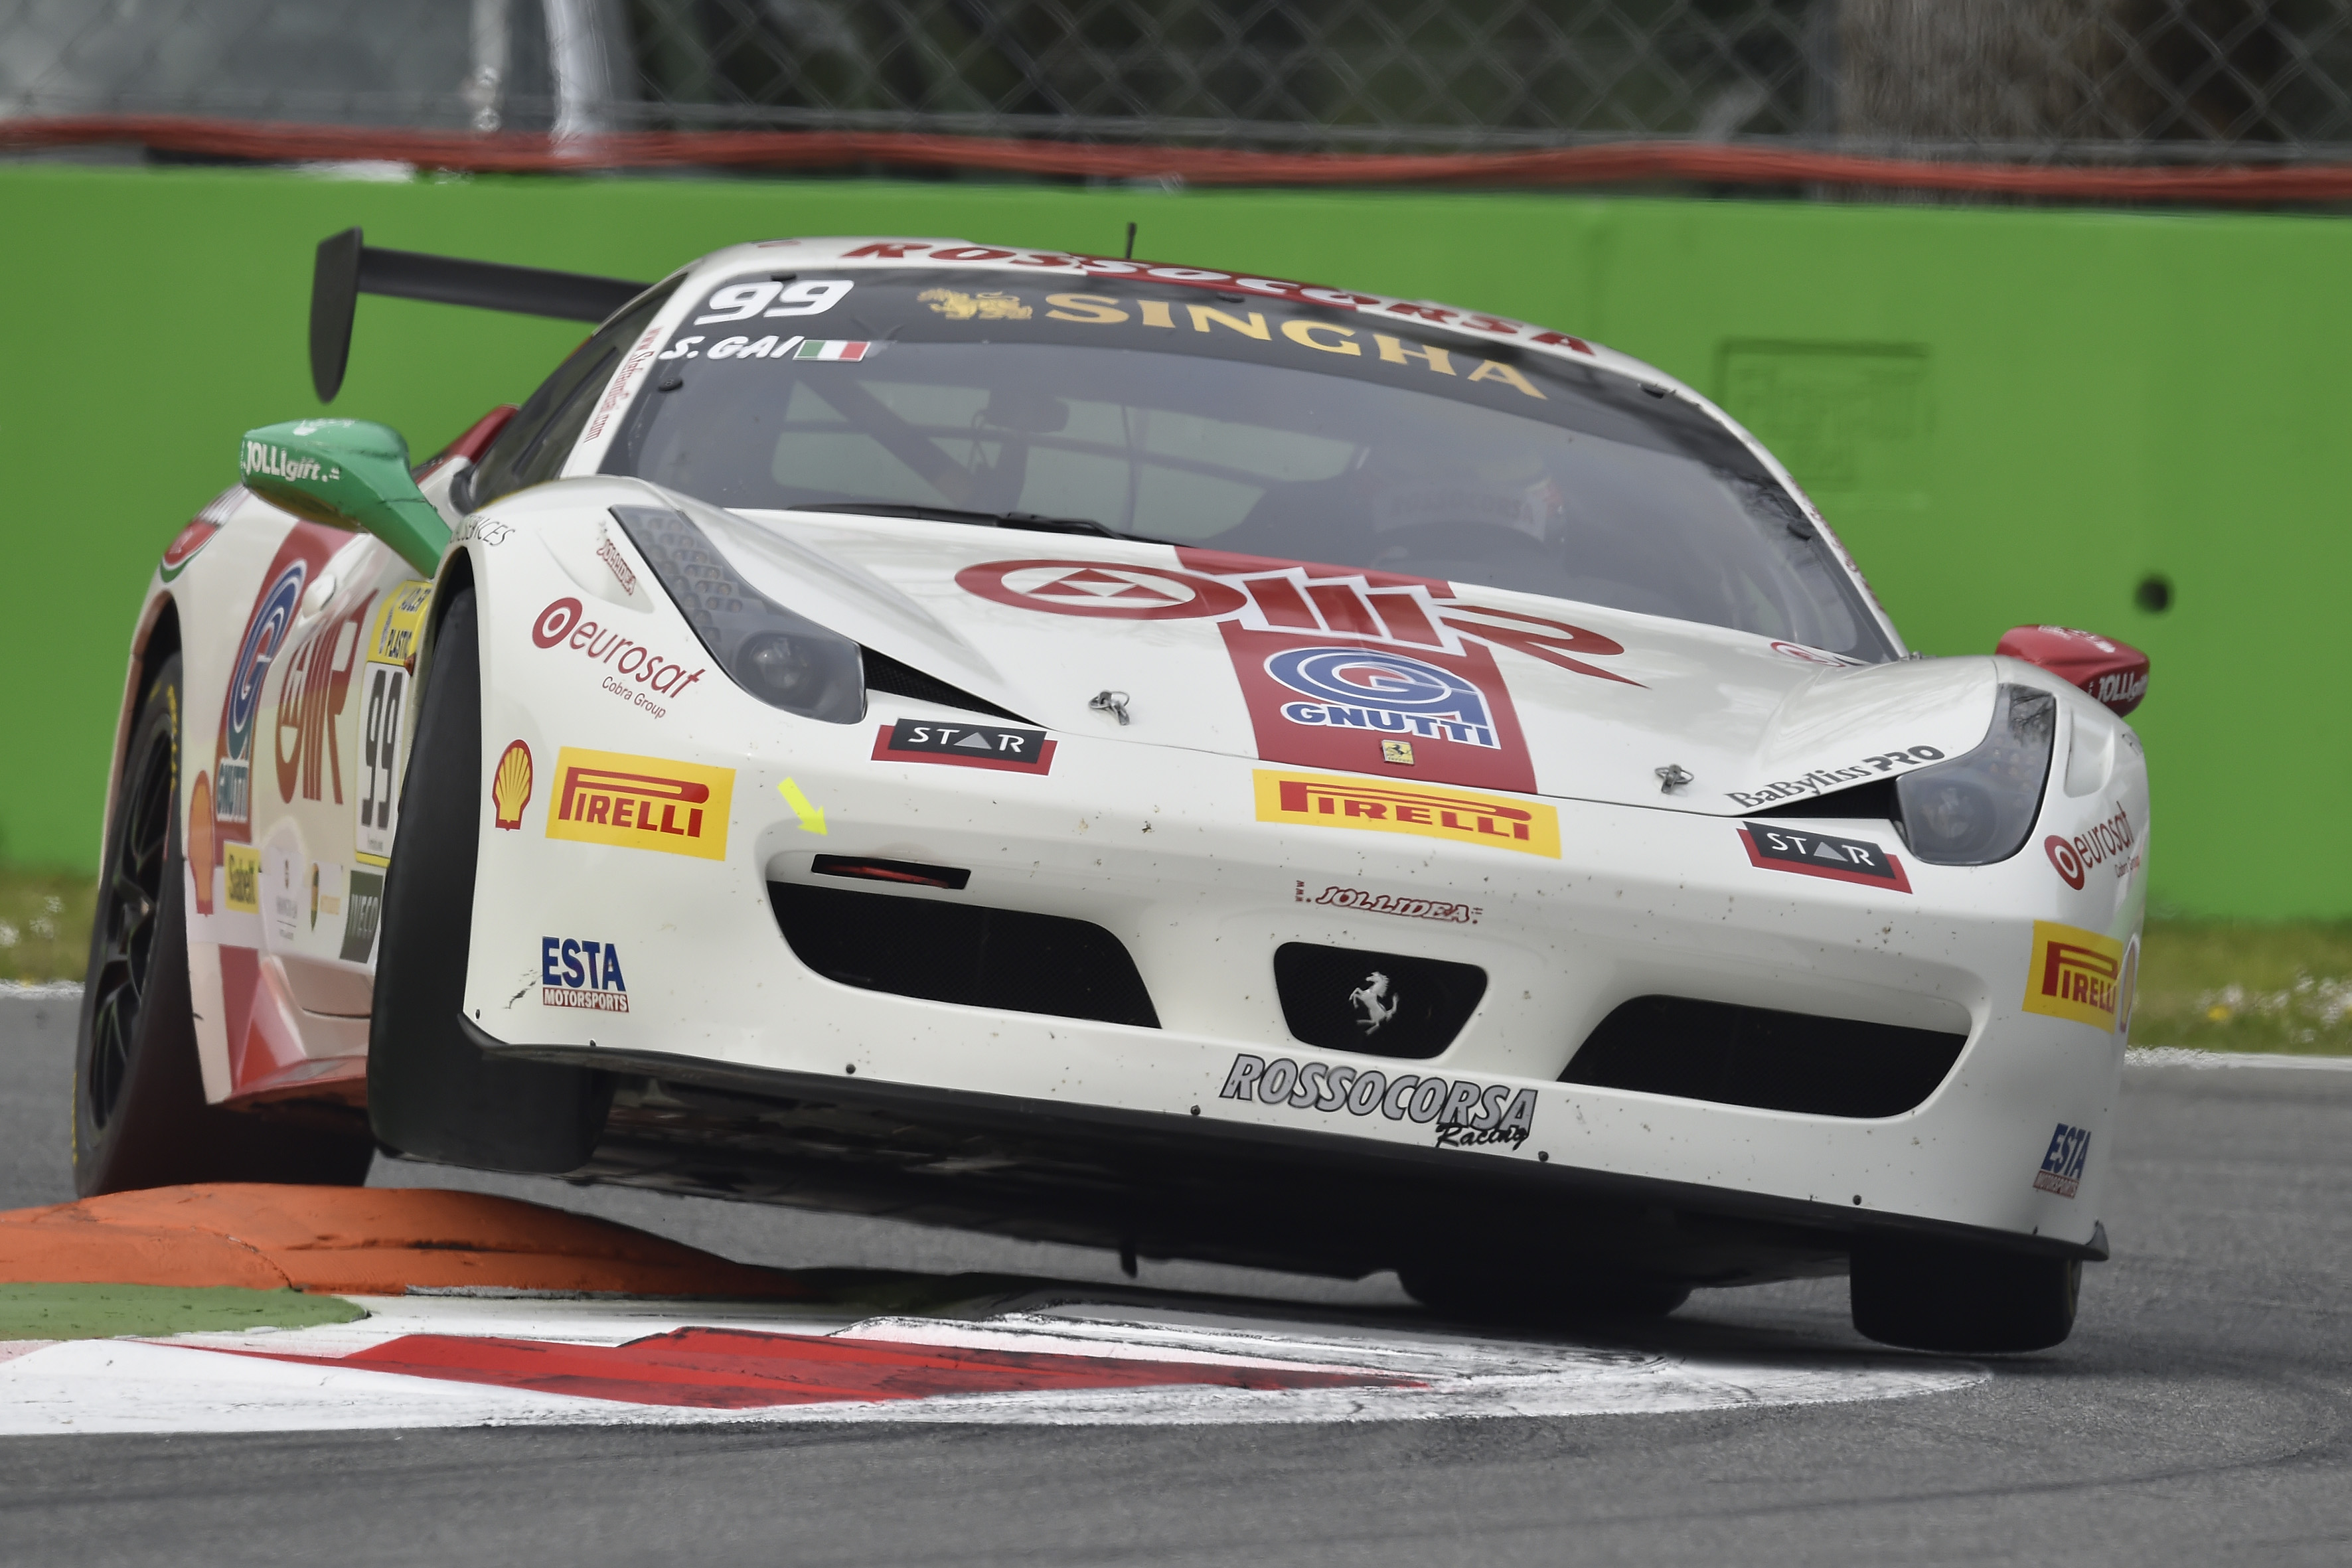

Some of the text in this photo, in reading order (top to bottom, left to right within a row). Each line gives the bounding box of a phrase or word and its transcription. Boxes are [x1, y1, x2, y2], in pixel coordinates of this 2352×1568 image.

[694, 279, 855, 325] 99
[840, 243, 1597, 357] ROSSOCORSA
[658, 335, 805, 360] S. GAI
[1045, 293, 1548, 400] SINGHA
[570, 621, 706, 698] eurosat
[602, 676, 666, 720] Cobra Group
[1281, 702, 1501, 749] GNUTTI
[362, 669, 403, 830] 99
[1723, 745, 1946, 808] BaByliss PRO
[558, 767, 710, 838] PIRELLI
[1279, 781, 1533, 840] PIRELLI
[542, 937, 626, 992] ESTA
[2042, 941, 2118, 1015] PIRELLI
[544, 988, 628, 1012] MOTORSPORTS
[1219, 1054, 1539, 1131] ROSSOCORSA
[1435, 1122, 1529, 1150] Racing
[2041, 1123, 2091, 1180] ESTA
